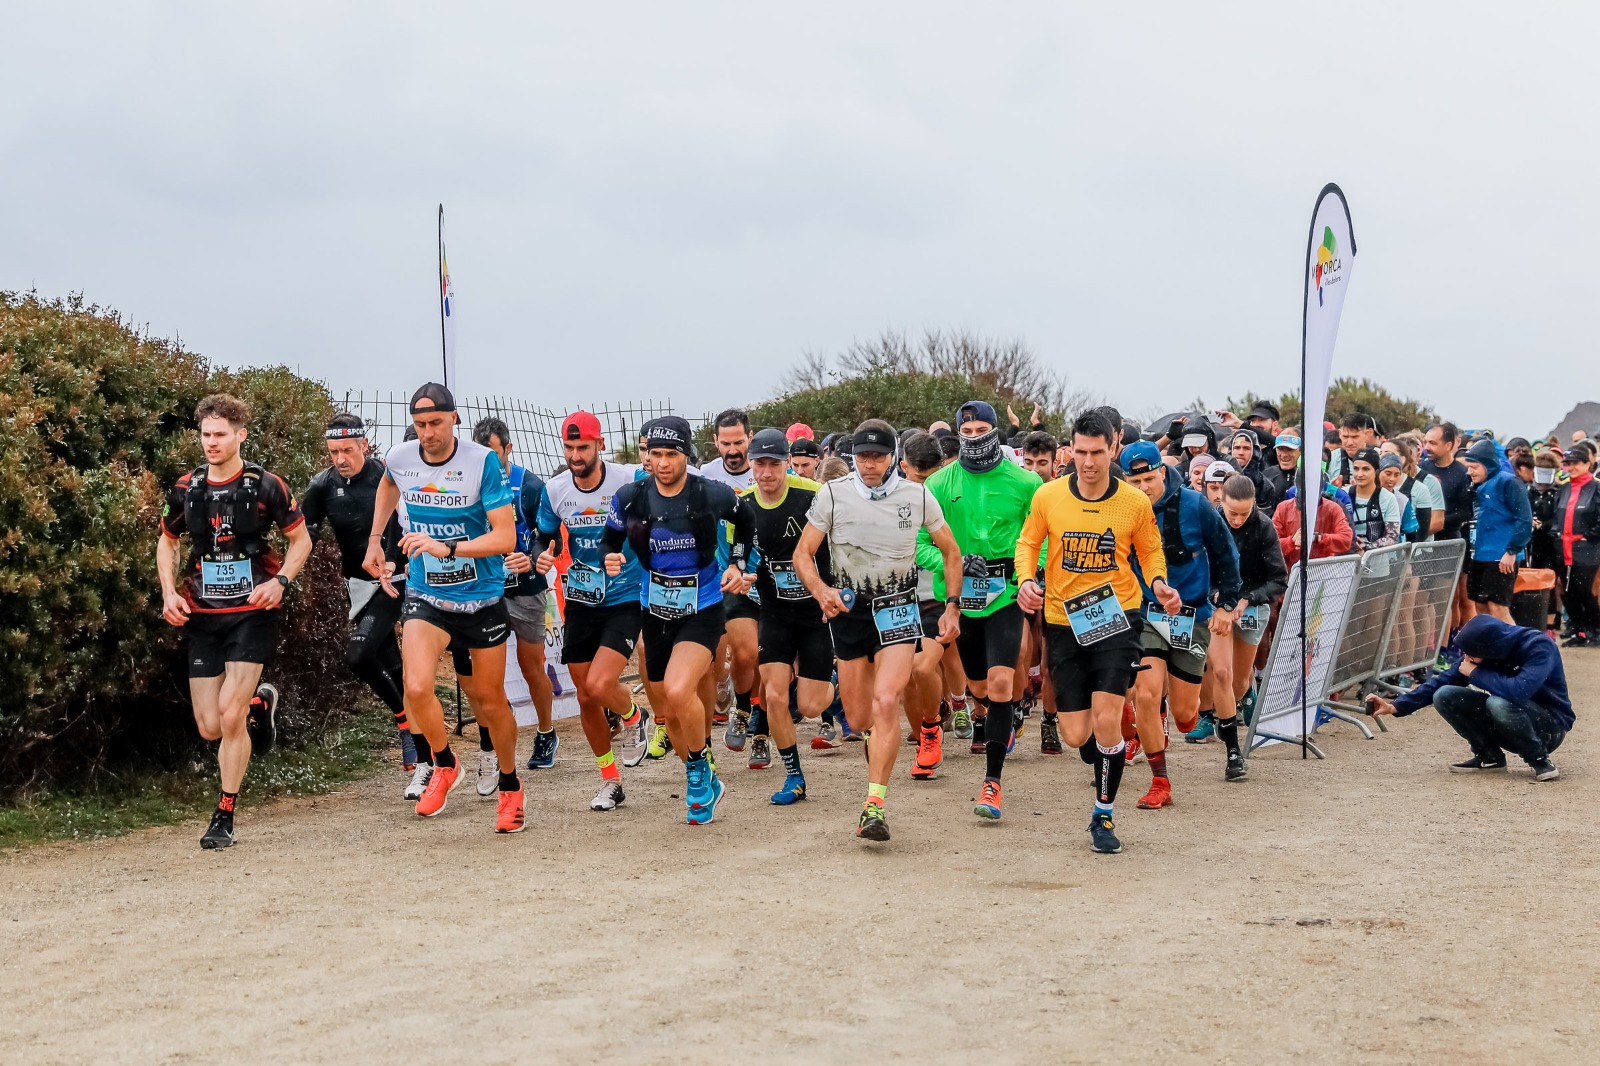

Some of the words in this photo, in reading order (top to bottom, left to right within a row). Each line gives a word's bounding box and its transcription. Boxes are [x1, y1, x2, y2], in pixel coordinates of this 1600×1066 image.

[434, 495, 469, 507] SPORT
[411, 521, 466, 536] TRITON
[898, 520, 913, 529] OTSO
[657, 537, 696, 548] indurco
[1063, 537, 1099, 552] TRAIL
[1077, 553, 1111, 567] FARS
[215, 564, 235, 576] 735
[575, 571, 591, 583] 883
[972, 579, 991, 590] 665
[661, 588, 681, 600] 777
[888, 606, 908, 621] 749
[1084, 604, 1105, 621] 664
[1161, 615, 1180, 627] 666
